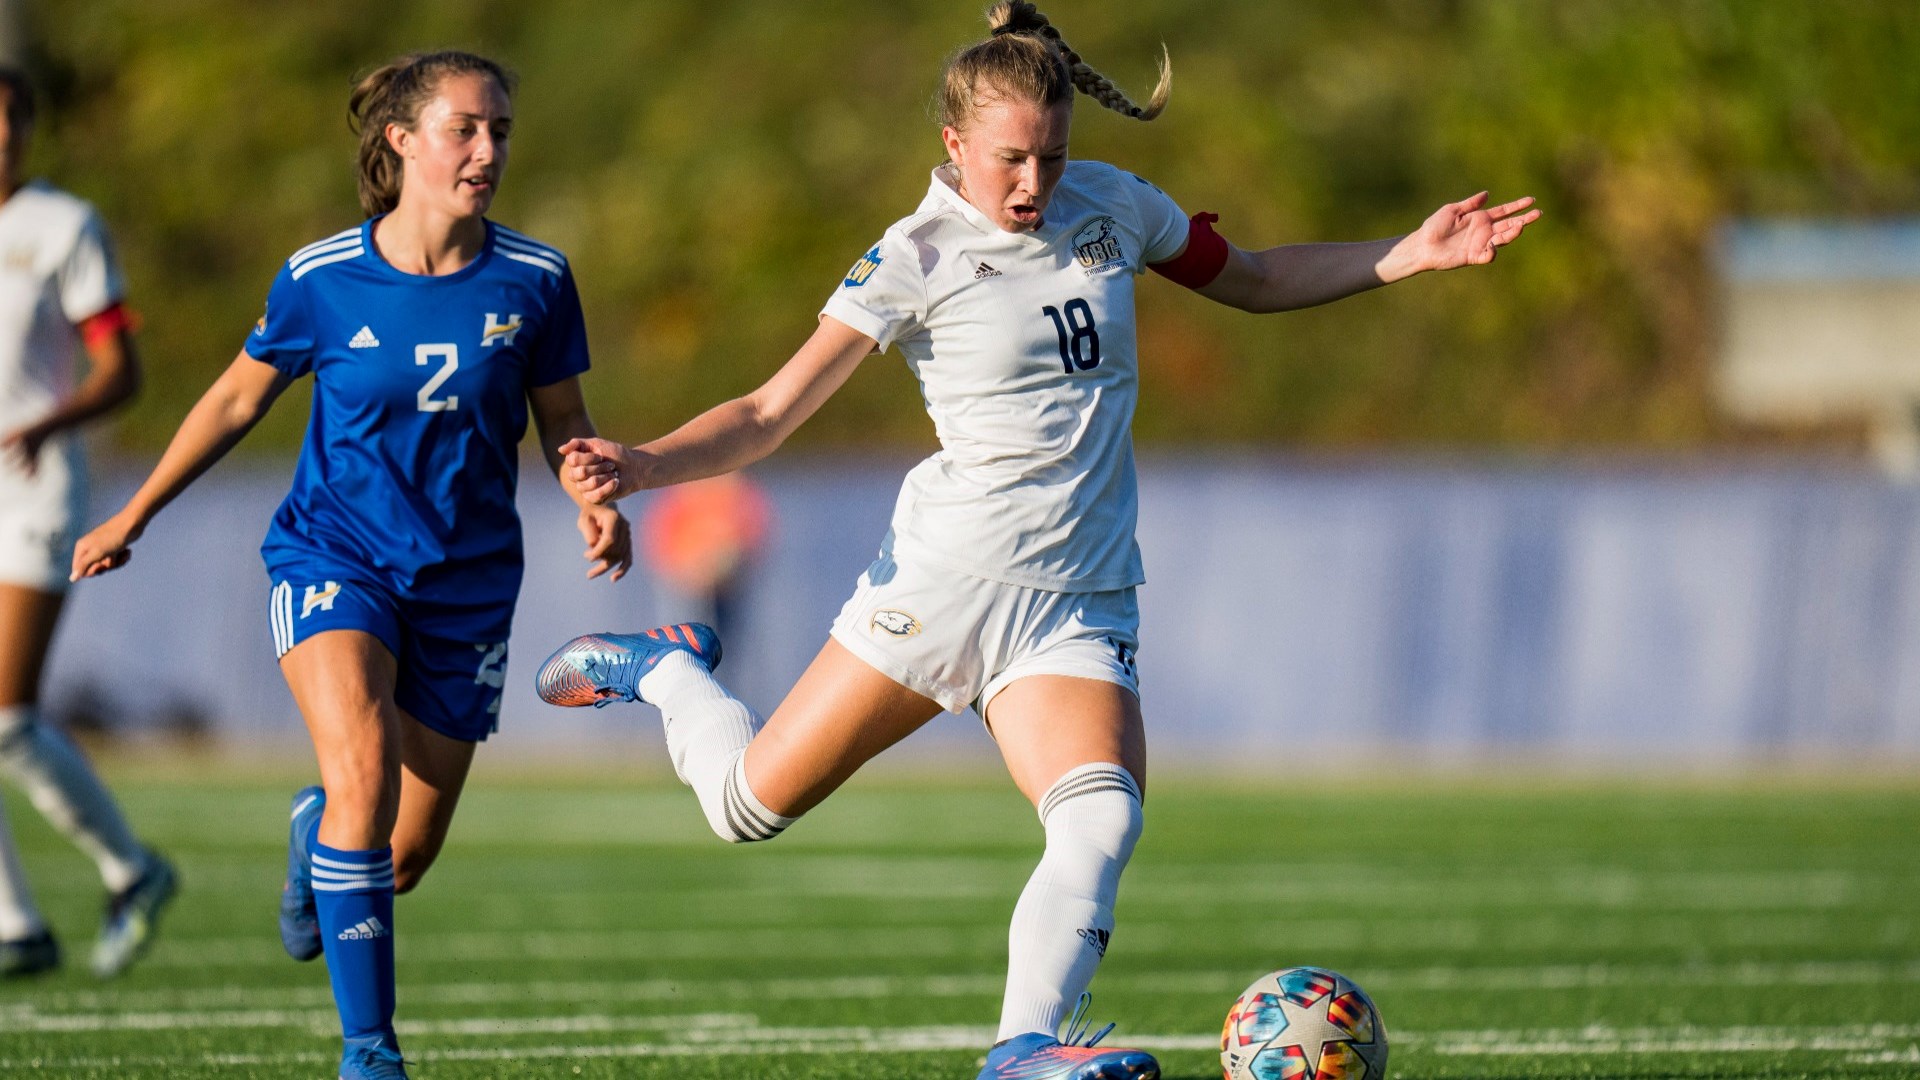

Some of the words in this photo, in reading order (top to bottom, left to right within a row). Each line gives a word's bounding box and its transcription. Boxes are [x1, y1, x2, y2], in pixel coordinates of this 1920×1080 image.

[974, 270, 1002, 279] adidas
[1072, 233, 1123, 266] UBC
[1042, 298, 1100, 374] 18
[415, 343, 459, 412] 2
